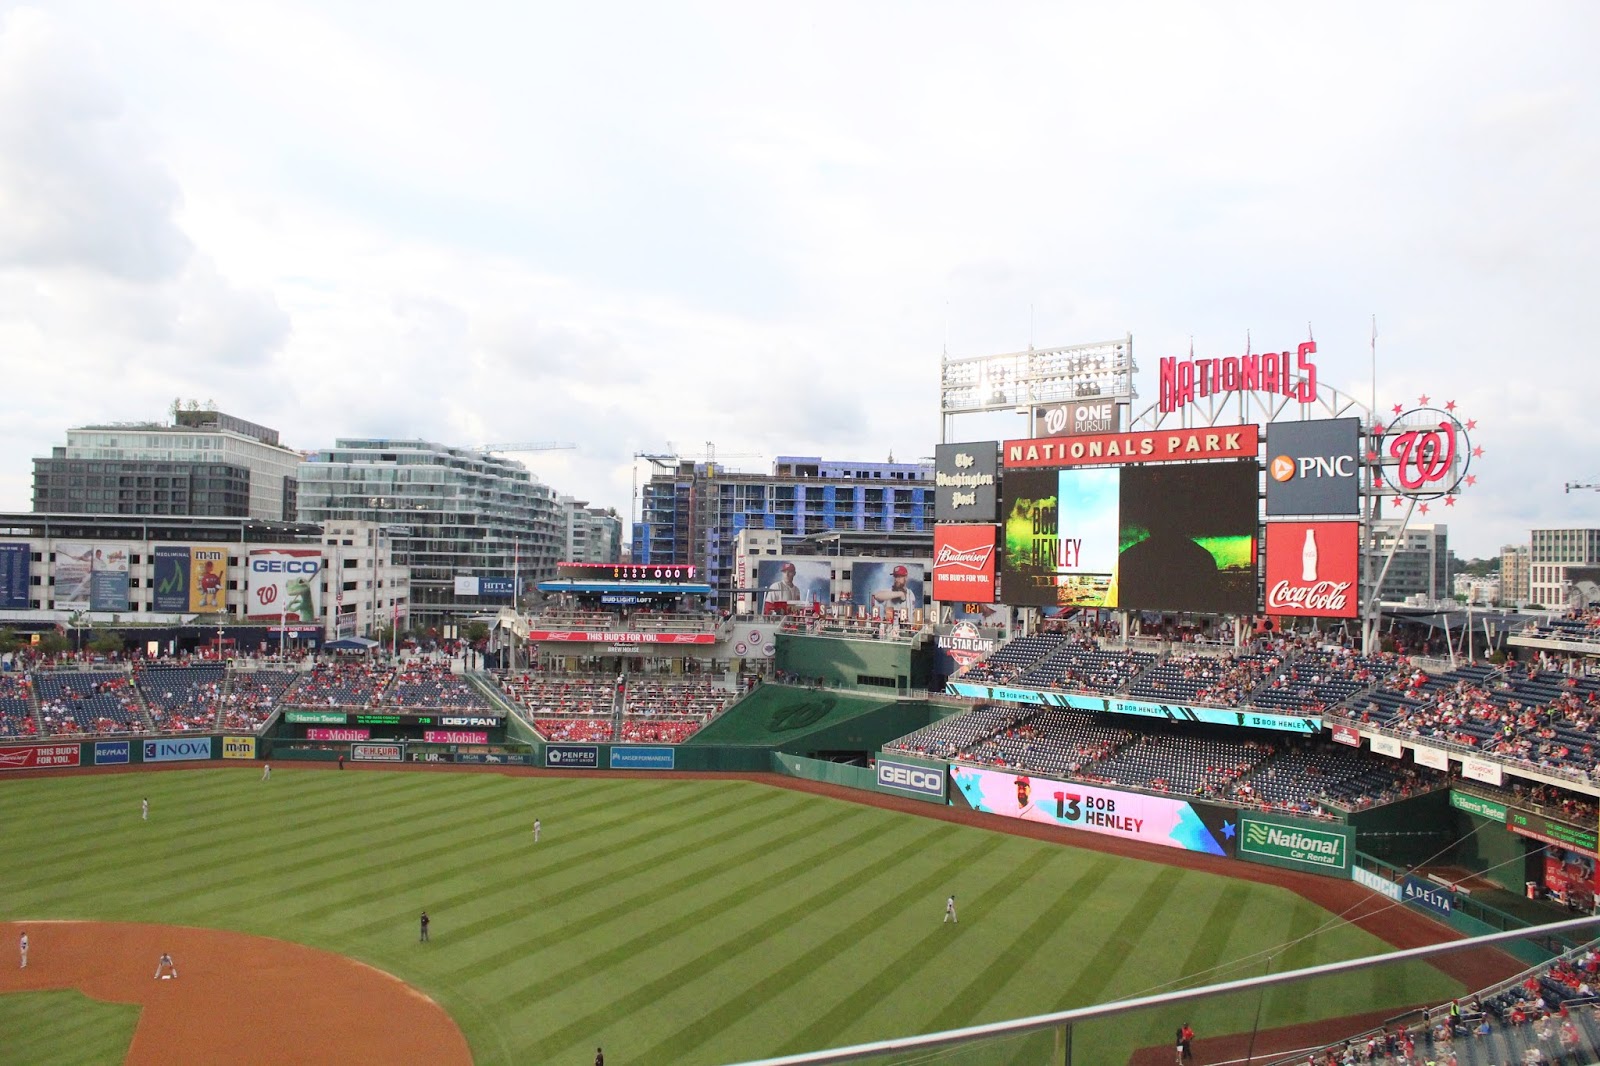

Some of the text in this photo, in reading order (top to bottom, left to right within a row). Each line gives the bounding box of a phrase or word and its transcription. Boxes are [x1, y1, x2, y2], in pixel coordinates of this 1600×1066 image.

[1160, 341, 1317, 413] NATIONALS
[1075, 404, 1112, 421] ONE
[1075, 419, 1111, 432] PURSUIT
[1010, 432, 1242, 461] NATIONALS PARK
[955, 453, 974, 469] The
[1390, 421, 1455, 489] W
[1298, 455, 1354, 478] PNC
[936, 470, 993, 488] Washington
[952, 492, 975, 509] Post
[938, 549, 987, 562] Budweiser
[1033, 538, 1081, 567] HENLEY
[253, 560, 318, 573] GEICO
[950, 574, 965, 582] BUD'S
[966, 574, 976, 582] FOR
[1269, 579, 1351, 610] Coca-Cola
[586, 632, 659, 642] THIS BUD'S FOR YOU.
[938, 637, 993, 652] ALL STAR GAME
[1139, 706, 1162, 714] HENLEY
[470, 718, 496, 726] FAN
[1252, 717, 1261, 725] 13
[1278, 720, 1306, 729] HENLEY
[36, 747, 78, 756] THIS BUD'S
[96, 748, 128, 756] RE/MAX
[161, 743, 209, 756] INOVA
[562, 751, 595, 759] PENFED
[36, 755, 70, 764] FOR YOU.
[880, 766, 940, 790] GEICO
[1053, 791, 1115, 820] 13 BOB
[1460, 798, 1505, 819] Harris Teeter
[1085, 810, 1144, 833] HENLEY
[1267, 828, 1339, 855] National
[1291, 850, 1335, 864] Car Rental
[1416, 886, 1450, 911] DELTA
